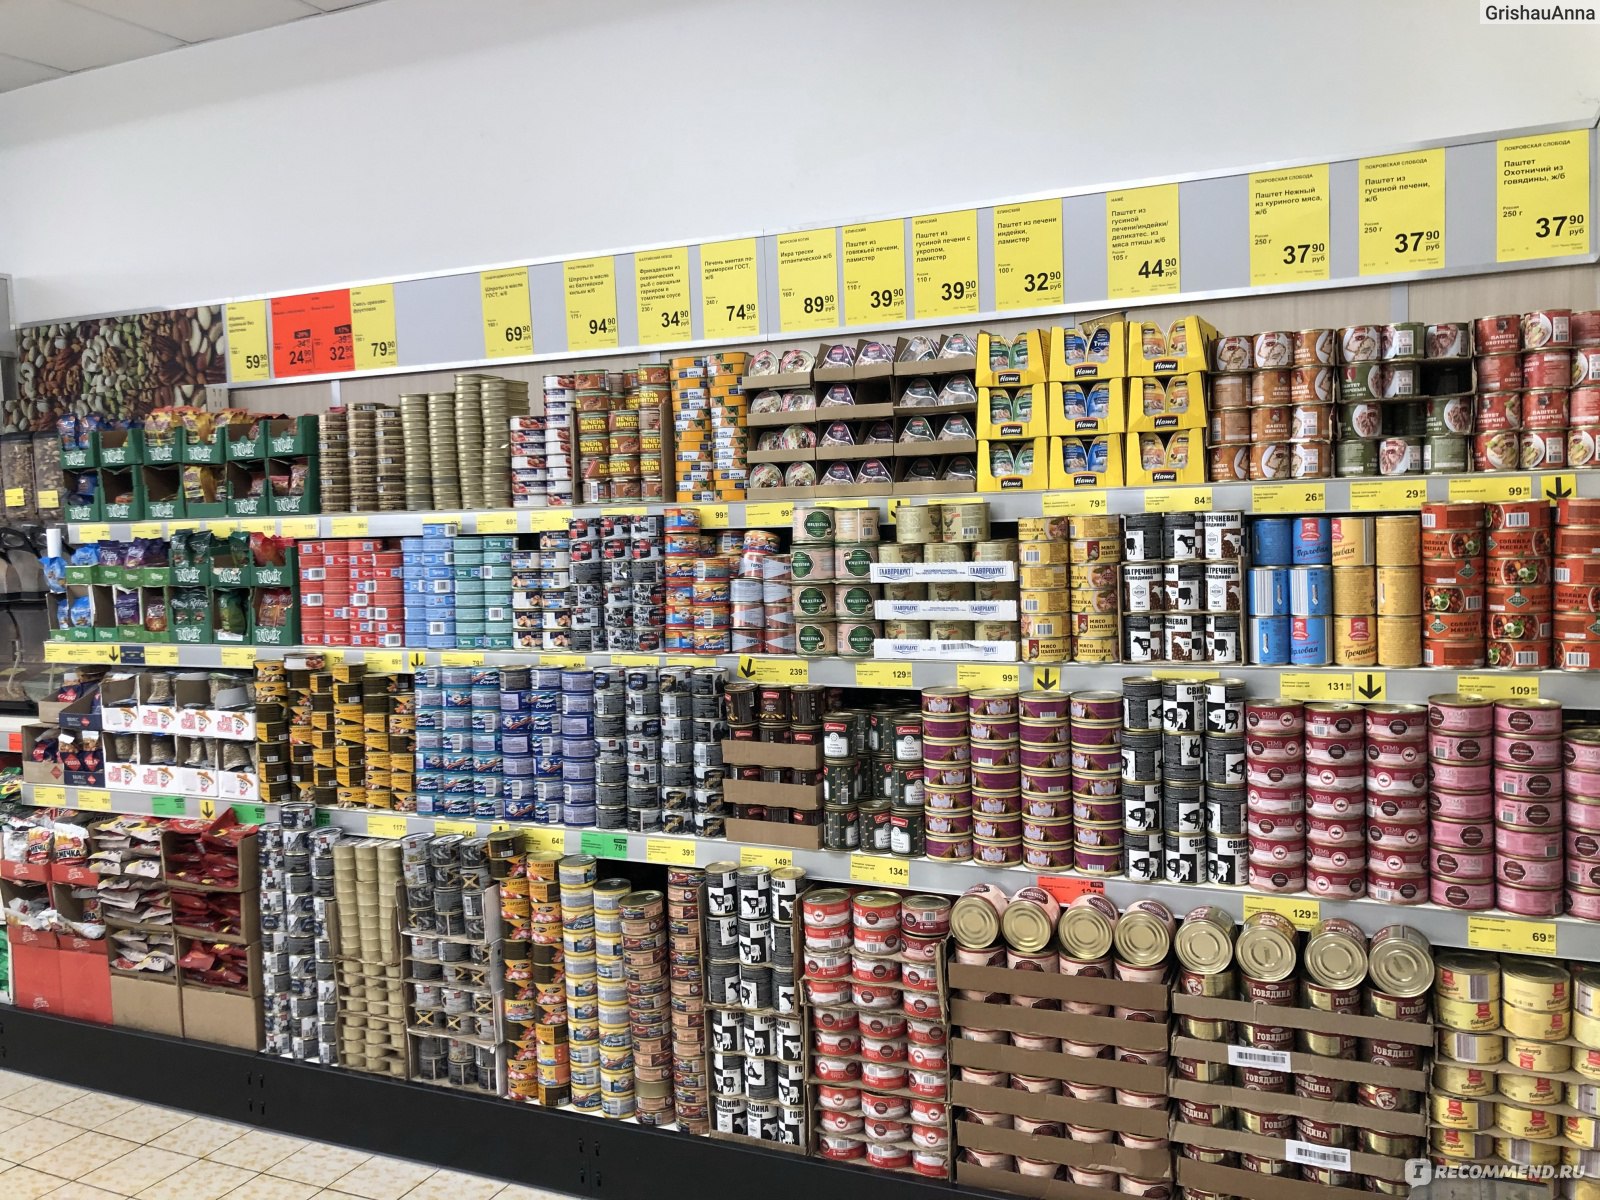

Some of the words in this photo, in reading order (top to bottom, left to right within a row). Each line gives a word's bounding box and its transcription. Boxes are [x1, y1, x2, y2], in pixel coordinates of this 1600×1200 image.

[1504, 143, 1542, 151] ПОКРОВСКАЯ
[1365, 161, 1400, 170] ПОКРОВСКАЯ
[1402, 158, 1427, 166] СЛОБОДА
[1504, 159, 1536, 167] Паштет
[1504, 166, 1551, 176] Охотничий
[1255, 176, 1288, 184] ПОКРОВСКАЯ
[1365, 177, 1394, 185] Паштет
[1504, 176, 1549, 185] говядины,
[1551, 172, 1565, 180] ж/б
[1256, 191, 1282, 199] Паштет
[1285, 187, 1316, 196] Нежный
[1365, 184, 1396, 195] гусиной
[1266, 197, 1299, 207] куриного
[1365, 195, 1377, 203] ж/б
[1111, 209, 1136, 217] Паштет
[998, 221, 1022, 229] Паштет
[1112, 216, 1139, 225] гусиной
[1536, 216, 1567, 238] 37
[1569, 214, 1584, 224] 90
[1569, 228, 1584, 236] руб
[916, 239, 941, 247] гусиной
[943, 236, 965, 244] печени
[998, 237, 1029, 245] ламистер
[1130, 238, 1152, 247] птицы
[1395, 232, 1424, 253] 37
[1426, 231, 1440, 240] 90
[1426, 243, 1440, 251] руб
[1283, 244, 1311, 264] 37
[1312, 243, 1325, 252] 90
[916, 254, 947, 263] ламистер
[1312, 255, 1325, 263] руб
[1139, 259, 1164, 278] 44
[1165, 258, 1176, 267] 90
[1165, 269, 1177, 277] руб
[1024, 273, 1048, 293] 32
[1050, 271, 1061, 280] 90
[941, 282, 964, 301] 39
[965, 280, 976, 289] 90
[1050, 283, 1061, 291] руб
[871, 289, 892, 308] 39
[894, 288, 903, 296] 90
[804, 296, 824, 314] 89
[825, 295, 834, 303] 90
[727, 304, 746, 321] 74
[661, 311, 680, 328] 34
[589, 319, 607, 334] 94
[608, 317, 615, 325] 90
[506, 327, 522, 342] 69
[330, 347, 345, 361] 32
[371, 342, 387, 357] 79
[246, 355, 260, 369] 59
[290, 351, 304, 365] 24
[1406, 490, 1418, 498] 29
[1508, 487, 1522, 496] 99
[1194, 496, 1205, 505] 84
[1305, 493, 1317, 502] 26
[1089, 500, 1100, 508] 79
[790, 668, 803, 676] 239
[1002, 674, 1012, 682] 99
[1327, 683, 1344, 691] 131
[1511, 686, 1530, 695] 109
[774, 858, 787, 866] 149
[889, 867, 903, 876] 134
[1292, 908, 1311, 919] 129
[1532, 933, 1546, 942] 69
[1252, 988, 1291, 999] ГОВЯДИНА
[1257, 1032, 1292, 1041] ГОВЯДИН
[1373, 1045, 1414, 1058] ГОВЯДИНА
[1246, 1073, 1283, 1084] ГОВЯДИНА
